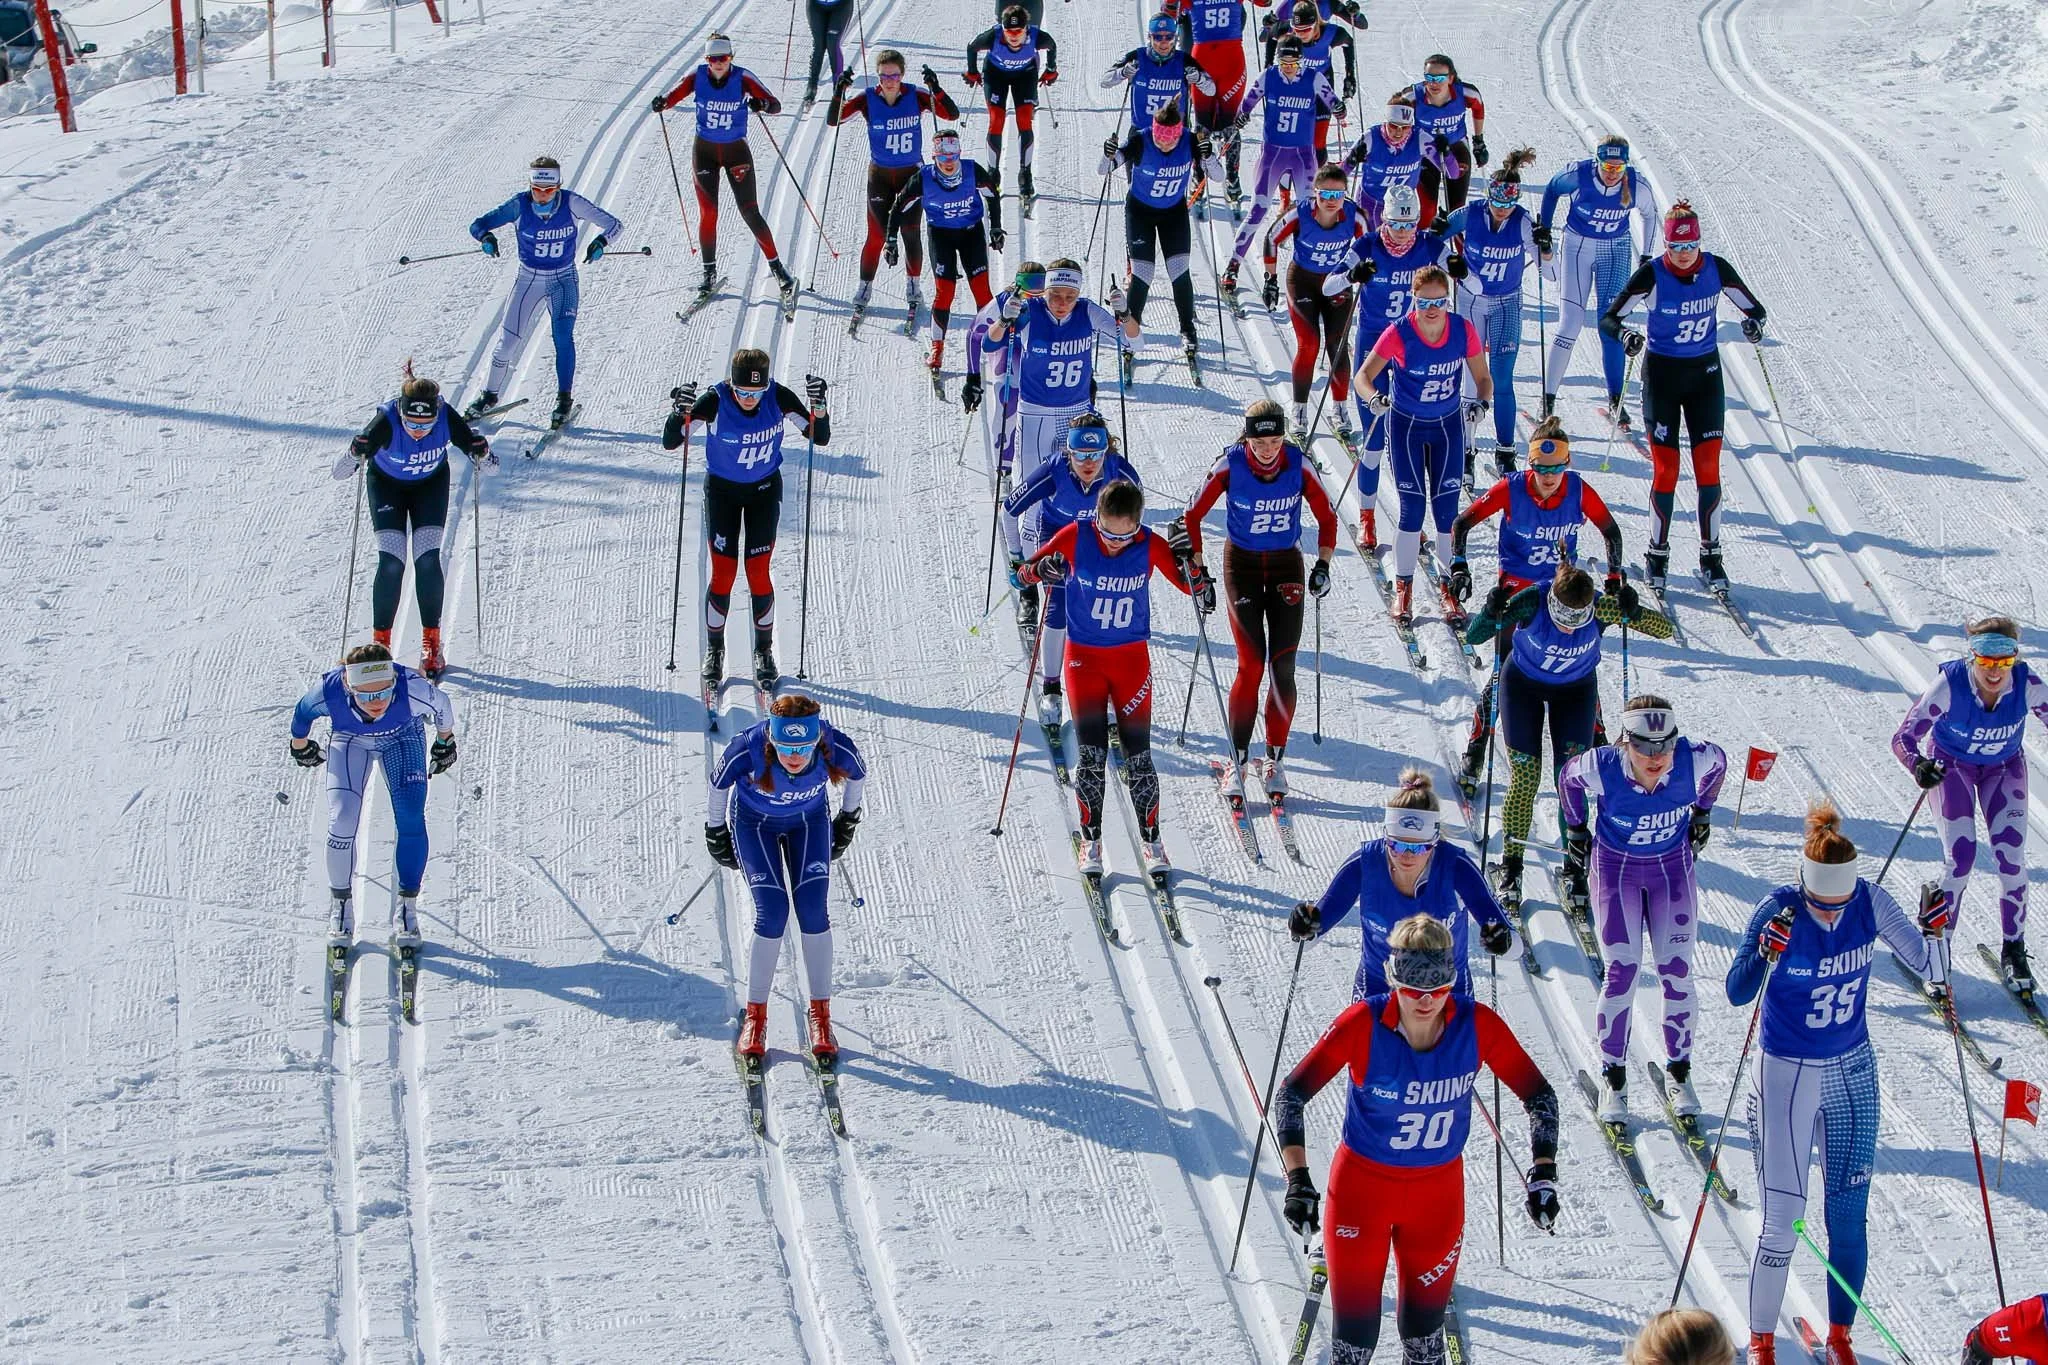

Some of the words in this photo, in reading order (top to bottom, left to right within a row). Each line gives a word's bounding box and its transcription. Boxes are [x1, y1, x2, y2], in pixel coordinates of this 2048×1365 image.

[1205, 8, 1231, 29] 58
[1148, 79, 1182, 91] SKIING
[1223, 70, 1247, 103] HARVA
[705, 101, 741, 112] SKIING
[1278, 96, 1312, 110] SKIING
[706, 112, 733, 131] 54
[886, 115, 920, 131] SKIING
[1277, 112, 1299, 133] 51
[1402, 109, 1415, 124] W
[885, 133, 913, 155] 46
[1150, 179, 1183, 198] 50
[1400, 206, 1413, 216] M
[536, 226, 575, 241] SKIING
[1482, 244, 1522, 258] SKIING
[1480, 261, 1510, 282] 41
[1661, 307, 1678, 316] NCAA
[1673, 318, 1711, 346] 39
[1032, 346, 1048, 355] NCAA
[1050, 336, 1092, 358] SKIING
[750, 371, 761, 384] B
[1045, 360, 1083, 388] 36
[1419, 379, 1455, 403] 29
[741, 421, 784, 445] SKIING
[737, 440, 774, 470] 44
[1250, 512, 1290, 535] 23
[1534, 521, 1583, 545] SKIING
[750, 545, 771, 558] BATES
[1095, 572, 1146, 595] SKIING
[1091, 599, 1134, 631] 40
[1539, 653, 1579, 674] 17
[1122, 672, 1152, 716] HARV
[1643, 712, 1668, 733] W
[1610, 815, 1632, 828] NCAA
[1786, 966, 1812, 978] NCAA
[1816, 941, 1873, 979] SKIING
[1805, 977, 1862, 1029] 35
[1372, 1087, 1399, 1101] NCAA
[1404, 1071, 1474, 1105] SKIING
[1389, 1109, 1456, 1151] 30
[1418, 1225, 1466, 1287] HARV
[1761, 1255, 1793, 1268] UNH
[1995, 1327, 2011, 1344] H
